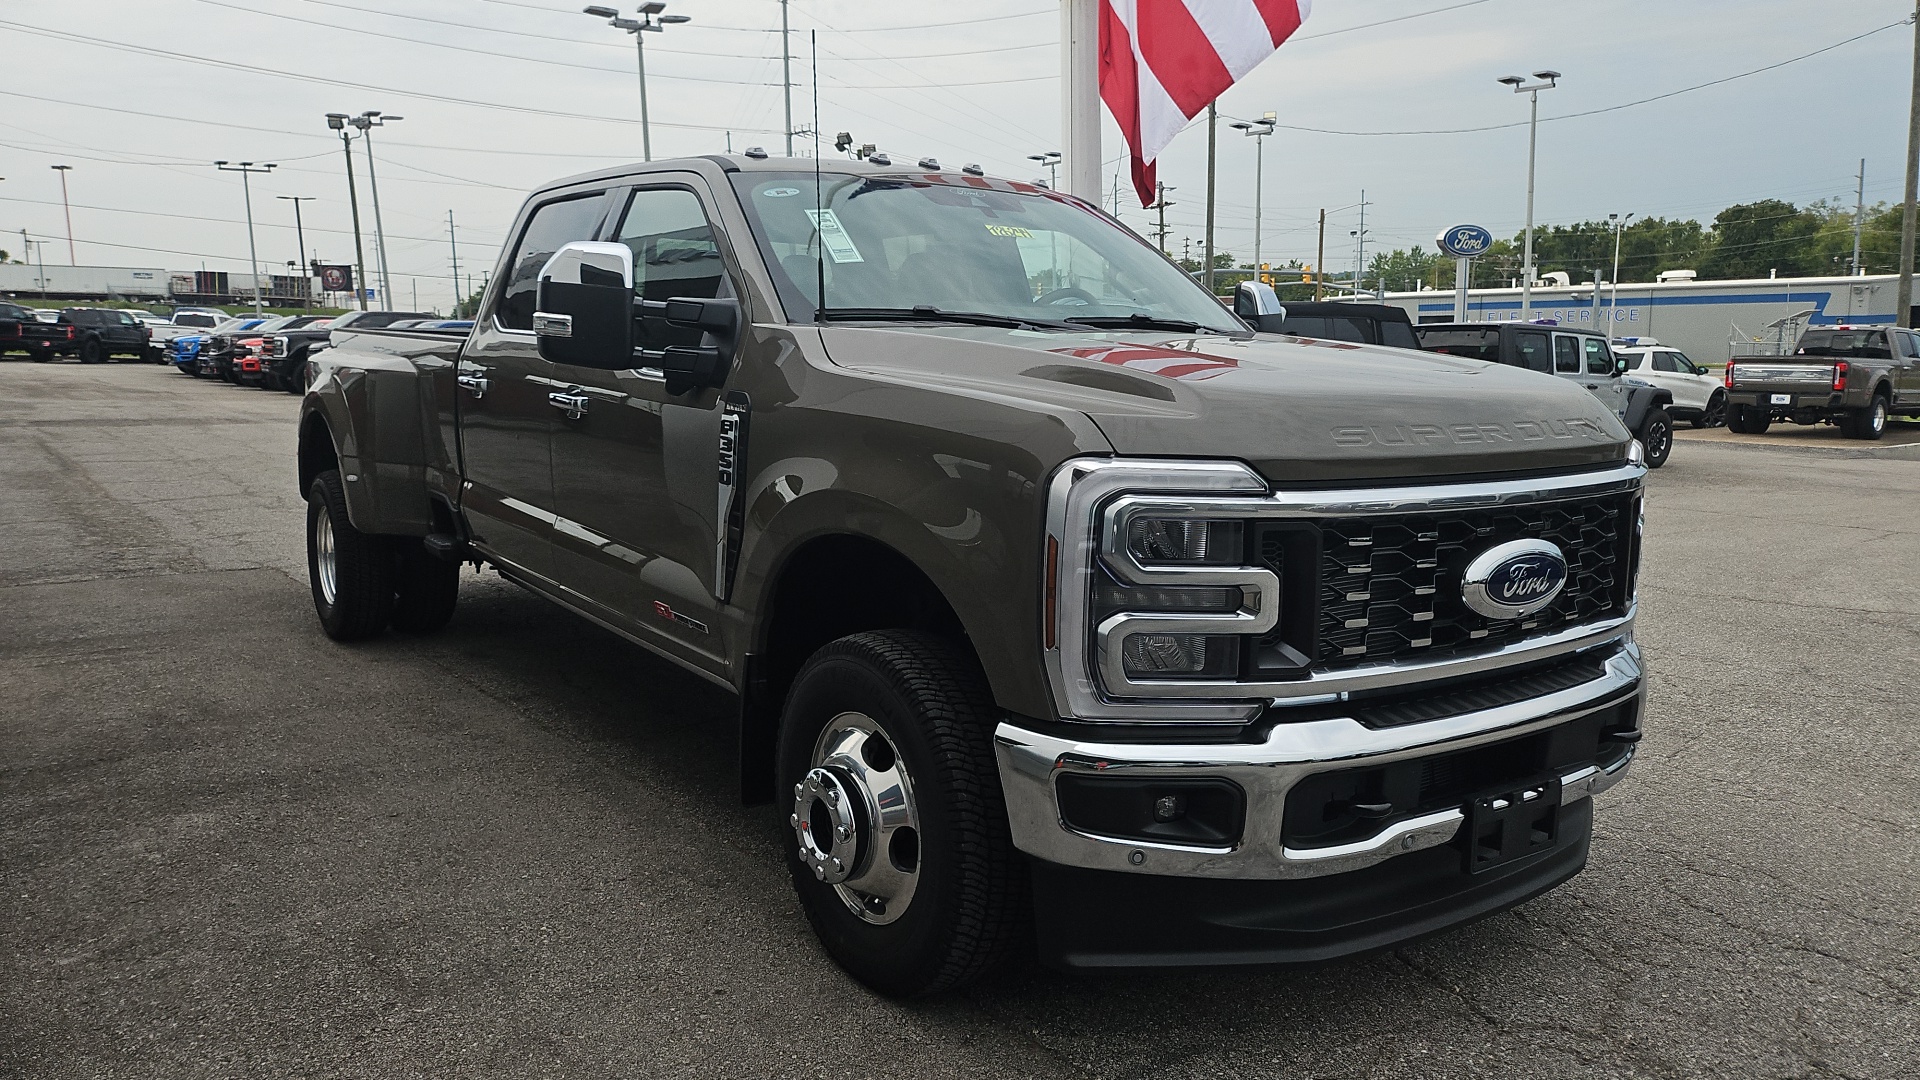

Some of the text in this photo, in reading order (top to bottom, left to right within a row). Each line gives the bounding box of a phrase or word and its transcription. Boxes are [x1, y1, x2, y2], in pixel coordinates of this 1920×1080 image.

[1454, 230, 1484, 250] Ford
[1487, 311, 1543, 322] FLET
[1330, 417, 1613, 447] SUPER DUTY
[1503, 562, 1551, 598] Ford
